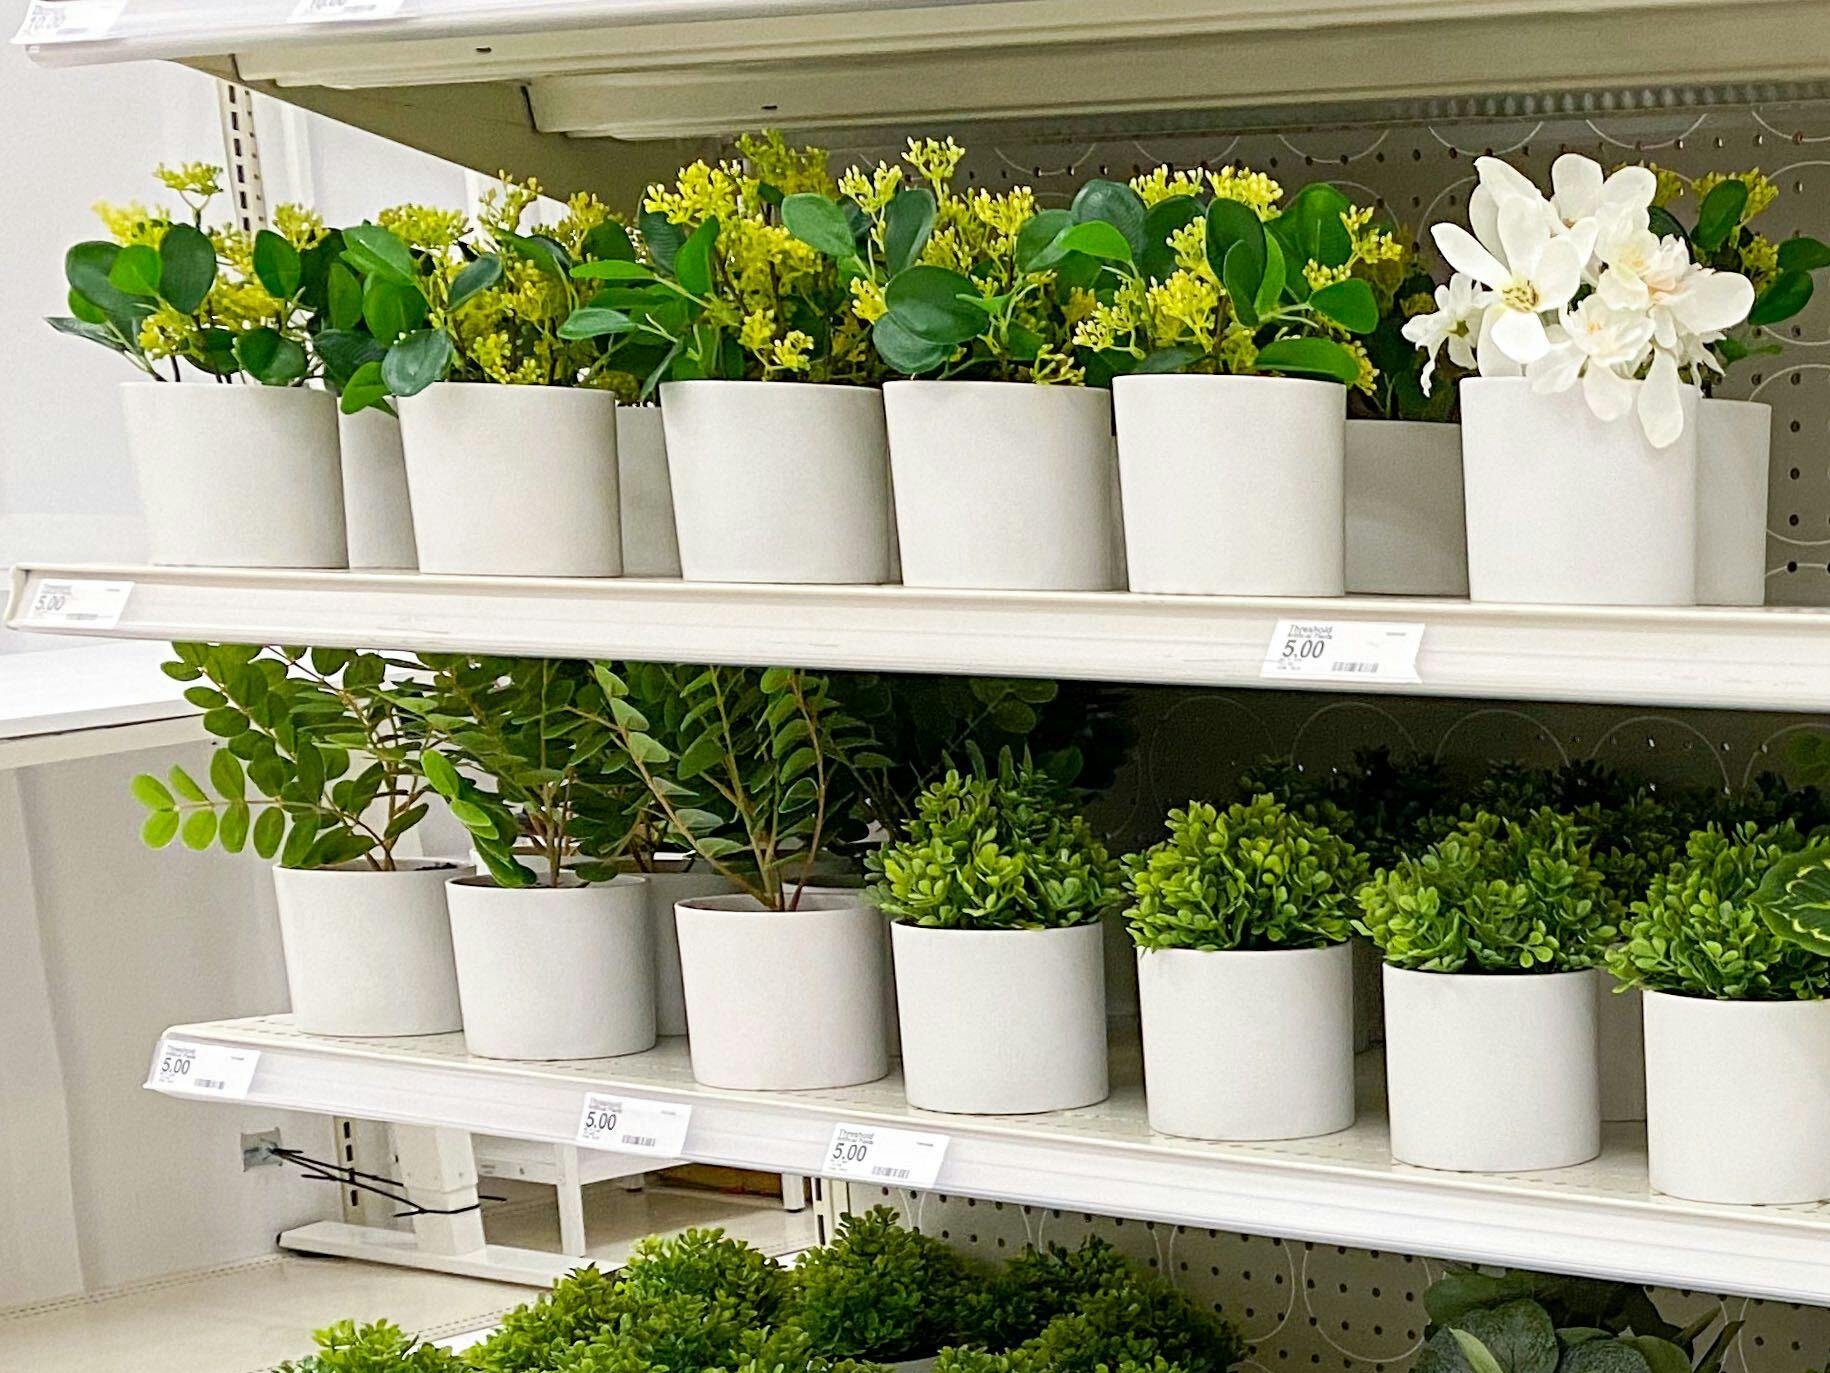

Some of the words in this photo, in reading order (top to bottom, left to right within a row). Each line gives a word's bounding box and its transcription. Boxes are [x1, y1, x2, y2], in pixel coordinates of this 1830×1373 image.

[35, 595, 65, 611] 5.00
[1282, 639, 1325, 658] 5.00
[161, 1057, 191, 1075] 5.00
[585, 1111, 617, 1131] 5.00
[832, 1142, 867, 1162] 5.00
